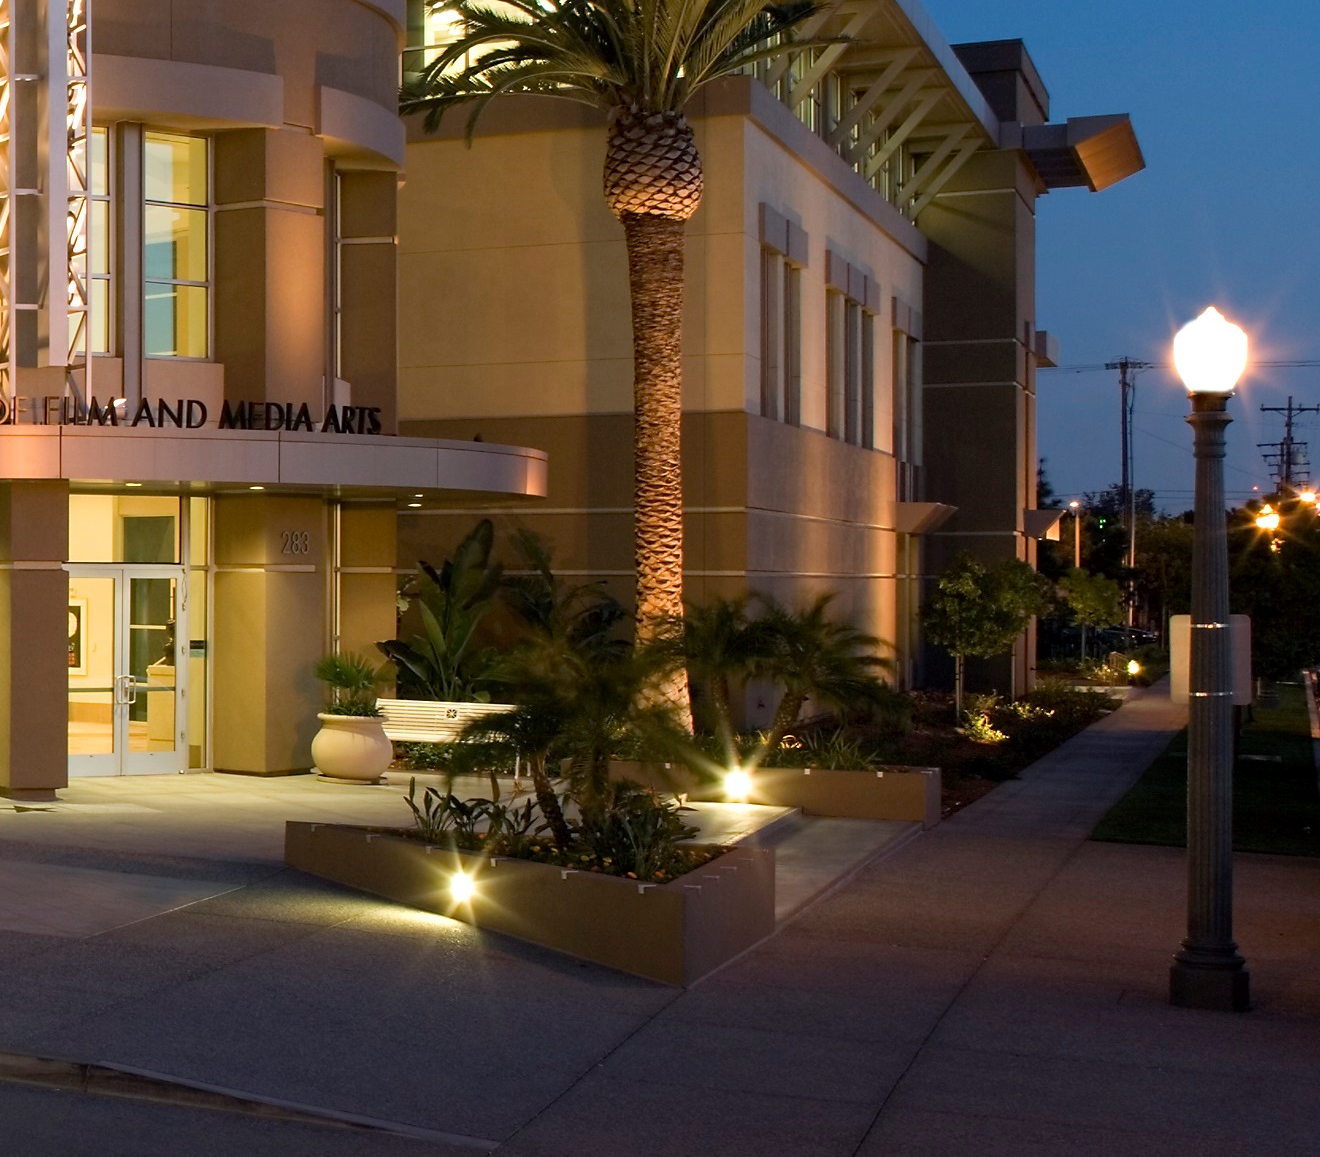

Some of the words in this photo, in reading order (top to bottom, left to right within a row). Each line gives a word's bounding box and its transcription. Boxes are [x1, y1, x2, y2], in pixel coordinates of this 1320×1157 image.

[44, 396, 118, 426] FILM
[131, 398, 207, 429] AND
[218, 399, 313, 431] MEDIA
[321, 404, 382, 435] ARTS
[282, 531, 310, 554] 283
